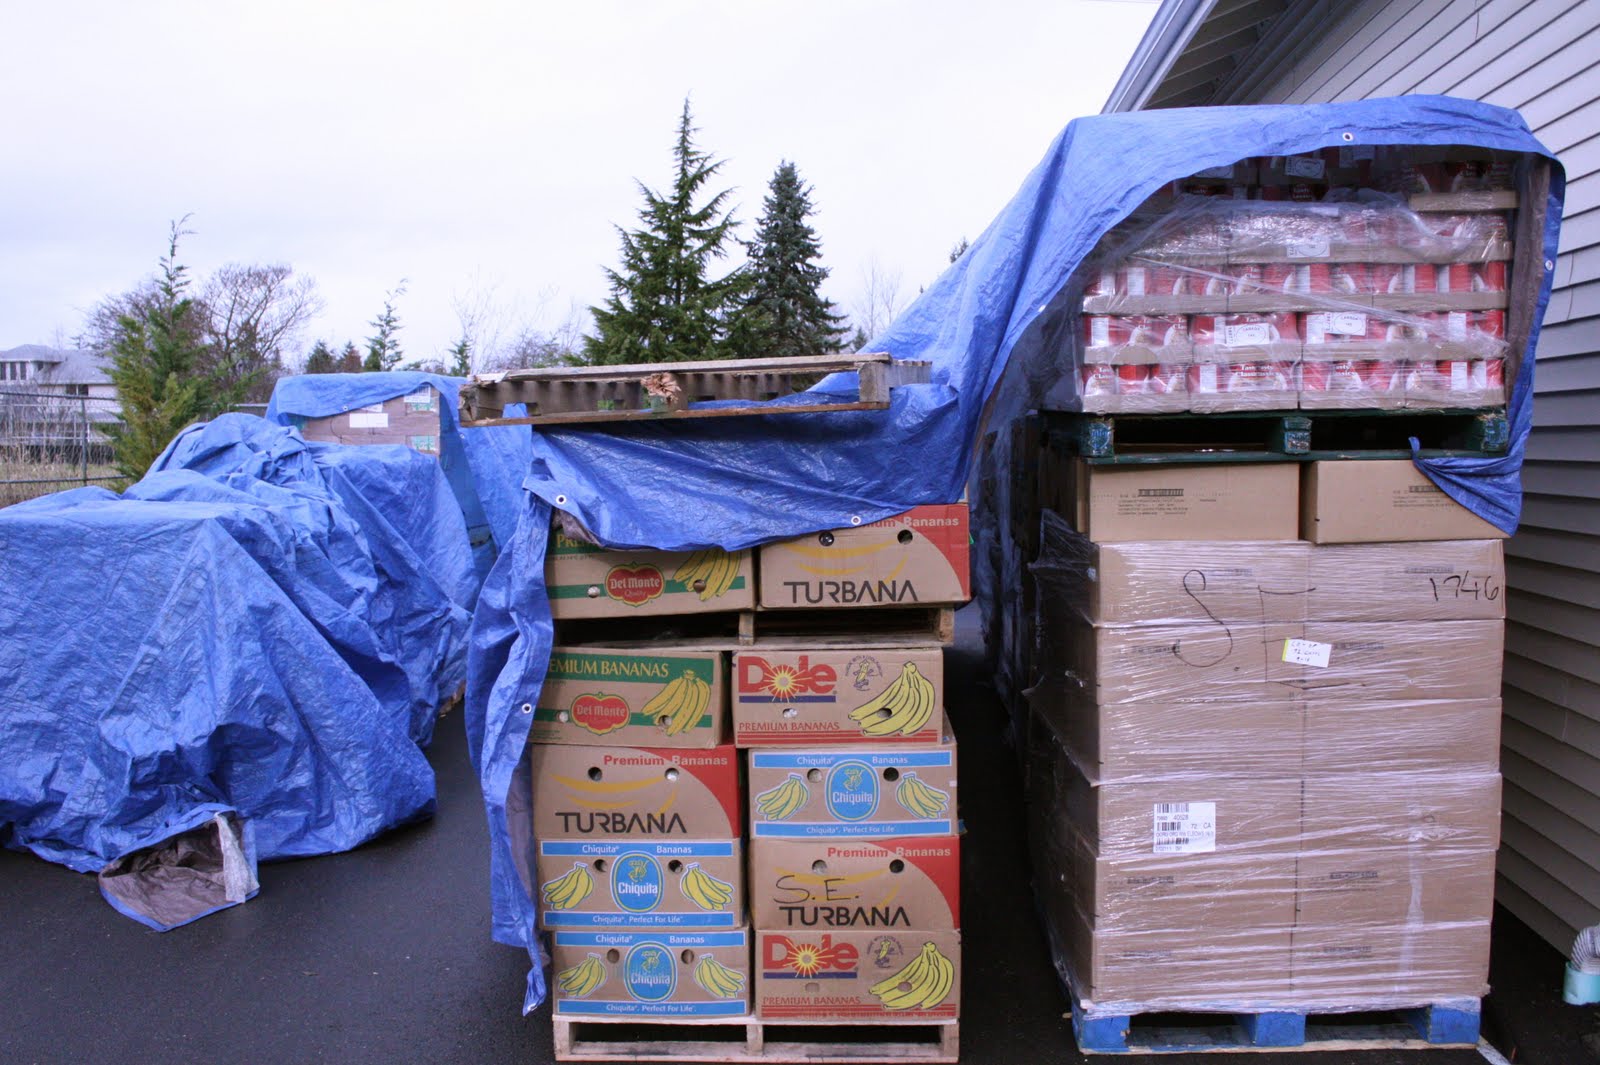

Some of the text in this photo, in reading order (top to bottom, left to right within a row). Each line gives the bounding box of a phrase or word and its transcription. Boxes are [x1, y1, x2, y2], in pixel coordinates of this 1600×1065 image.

[903, 516, 960, 527] Bananas
[610, 576, 661, 590] Del Monte
[1429, 570, 1499, 602] 1746
[783, 580, 918, 604] TURBANA
[550, 658, 669, 678] EMIUM BANANAS
[738, 655, 837, 698] Dole
[576, 705, 626, 717] Del Monte
[738, 721, 840, 731] PREMIUM BANANAS
[603, 755, 728, 766] Premium Bananas
[872, 755, 908, 764] Bananas
[832, 790, 873, 806] Chiquita
[555, 811, 687, 834] TURBANA
[843, 825, 867, 833] Perfect
[656, 845, 692, 854] Bananas
[827, 846, 951, 858] Premium Bananas
[618, 881, 658, 897] Chiquita
[629, 915, 653, 923] Perfect
[655, 915, 666, 923] For
[779, 906, 911, 926] TURBANA
[669, 935, 705, 944] Bananas
[762, 933, 859, 975] Dole
[630, 971, 671, 987] Chiquita
[763, 996, 861, 1005] PREMIUM BANANAS
[642, 1004, 666, 1012] Perfect
[667, 1004, 679, 1012] For
